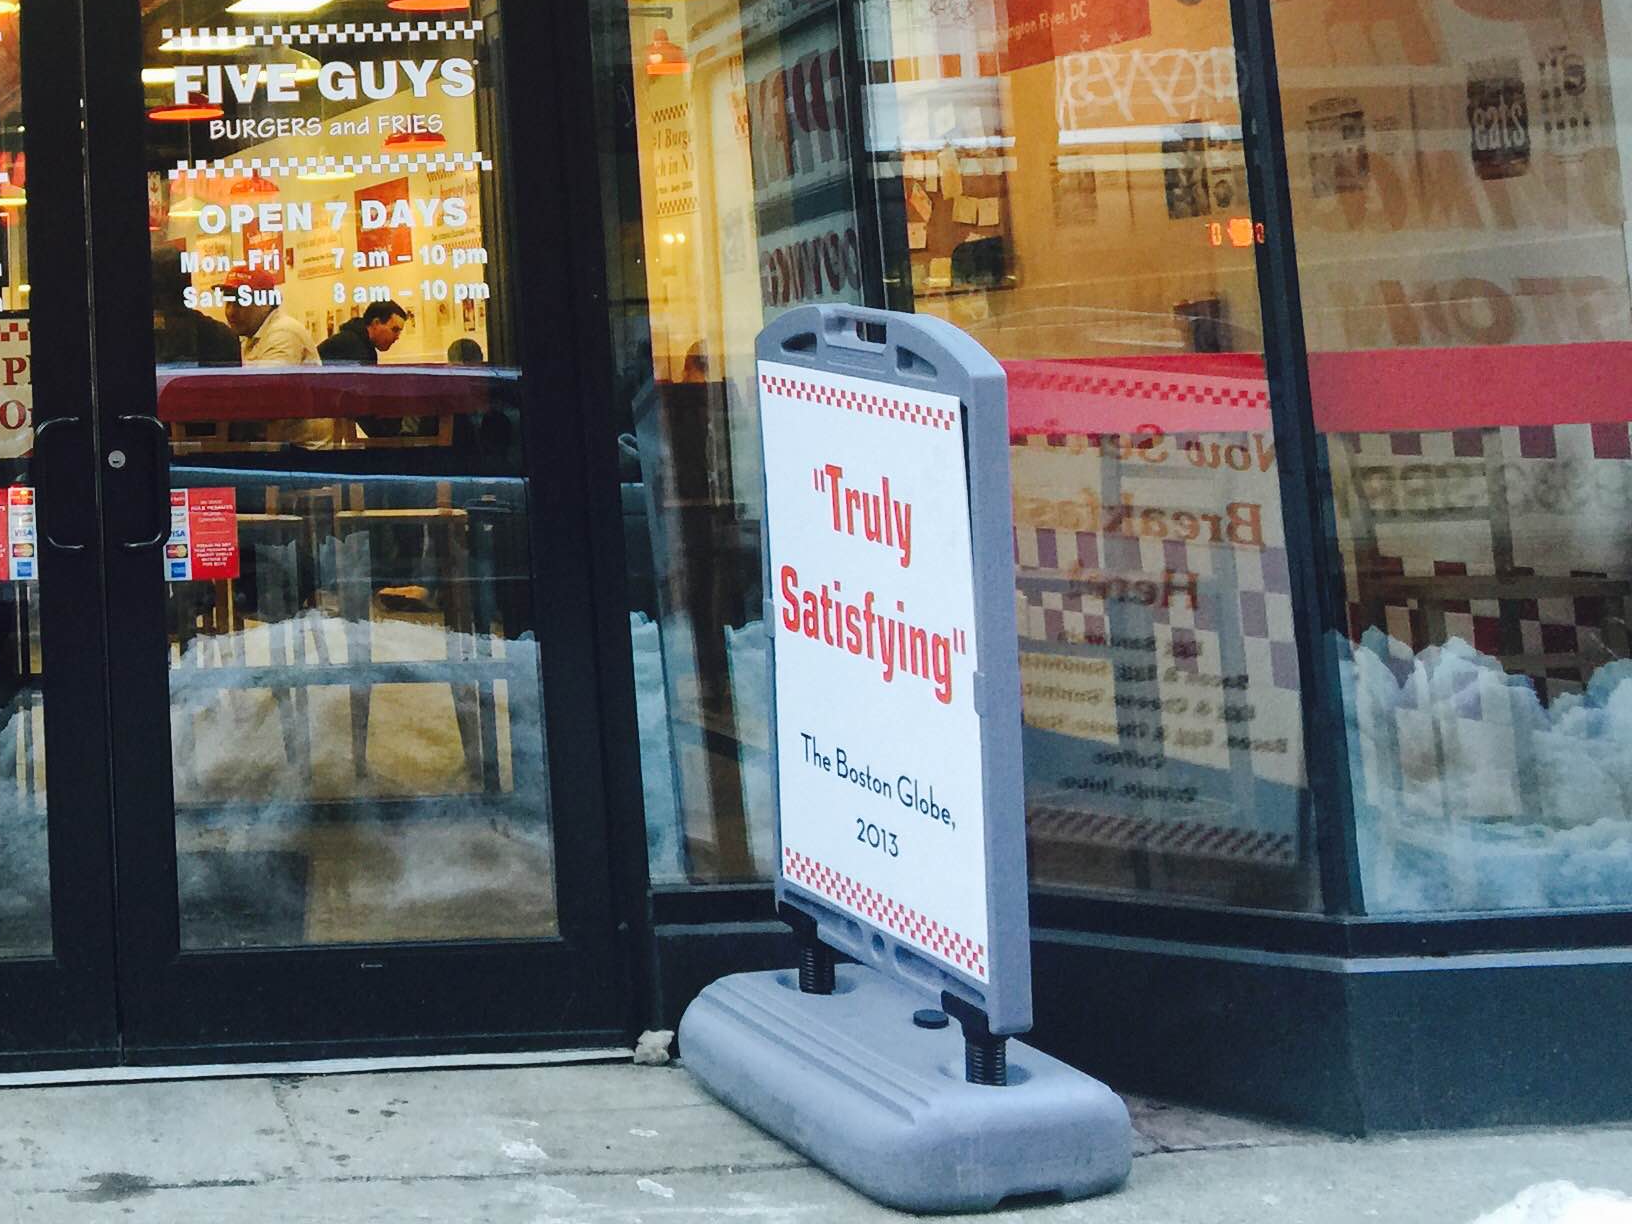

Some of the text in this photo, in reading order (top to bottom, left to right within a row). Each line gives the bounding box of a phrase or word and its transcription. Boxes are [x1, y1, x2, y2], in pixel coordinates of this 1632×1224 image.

[173, 57, 476, 105] FIVE GUYS
[209, 113, 444, 140] BURGERS and FRIES
[198, 197, 469, 234] OPEN 7 DAYS
[333, 247, 345, 269] 7
[352, 248, 390, 268] am
[419, 244, 447, 266] 10
[452, 244, 488, 269] pm
[352, 283, 391, 303] am
[419, 279, 447, 301] 10
[453, 279, 491, 302] pm
[779, 565, 967, 705] Satisfying"
[799, 732, 958, 831] The Boston Globe,
[854, 816, 901, 860] 2013
